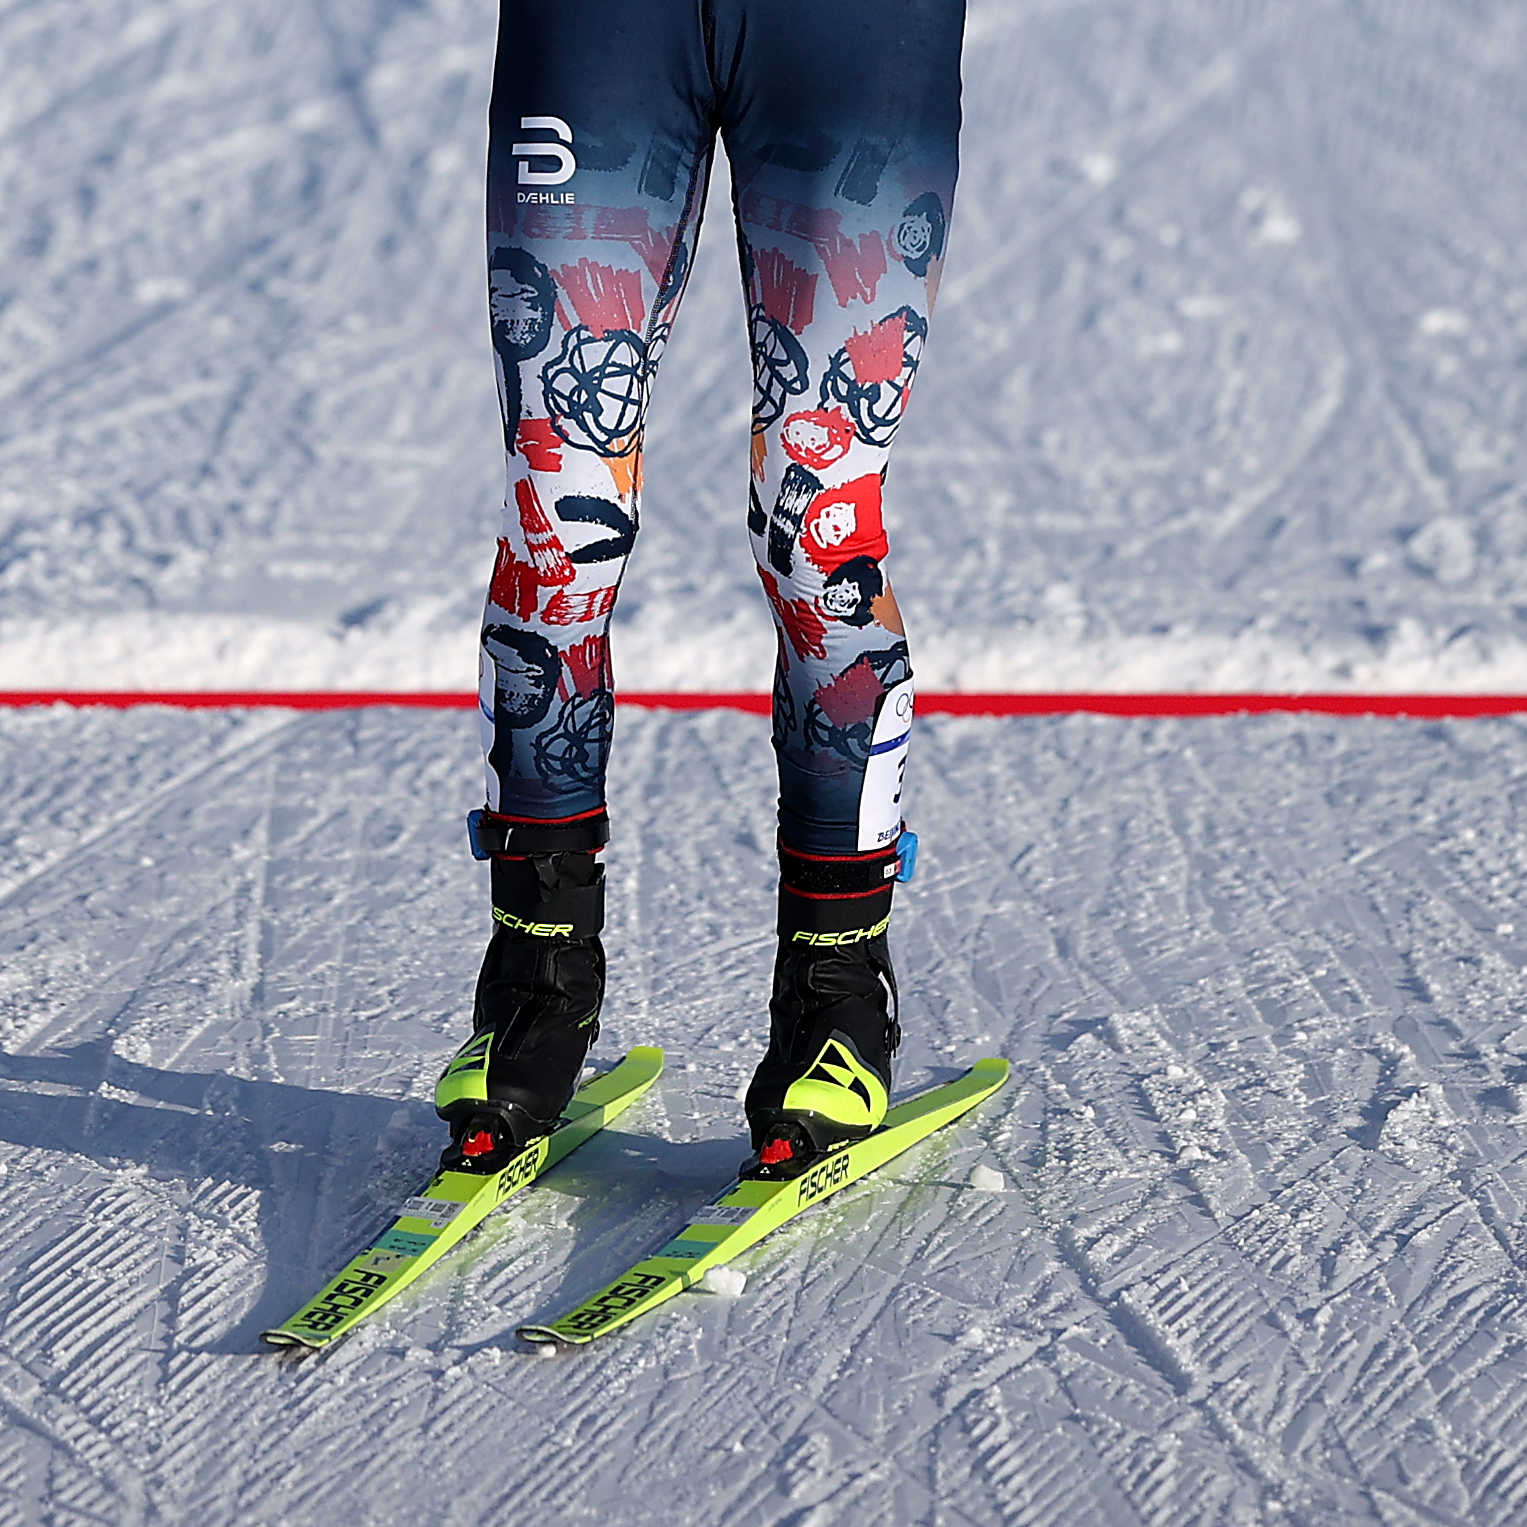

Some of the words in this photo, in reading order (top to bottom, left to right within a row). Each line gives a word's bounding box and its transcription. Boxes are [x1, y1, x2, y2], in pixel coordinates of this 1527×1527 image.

[491, 905, 574, 937] SCHER
[495, 1147, 540, 1203] FISCHER
[797, 1153, 850, 1208] FISCHER
[292, 1268, 388, 1332] FISCHER
[556, 1272, 667, 1331] FISCHER
